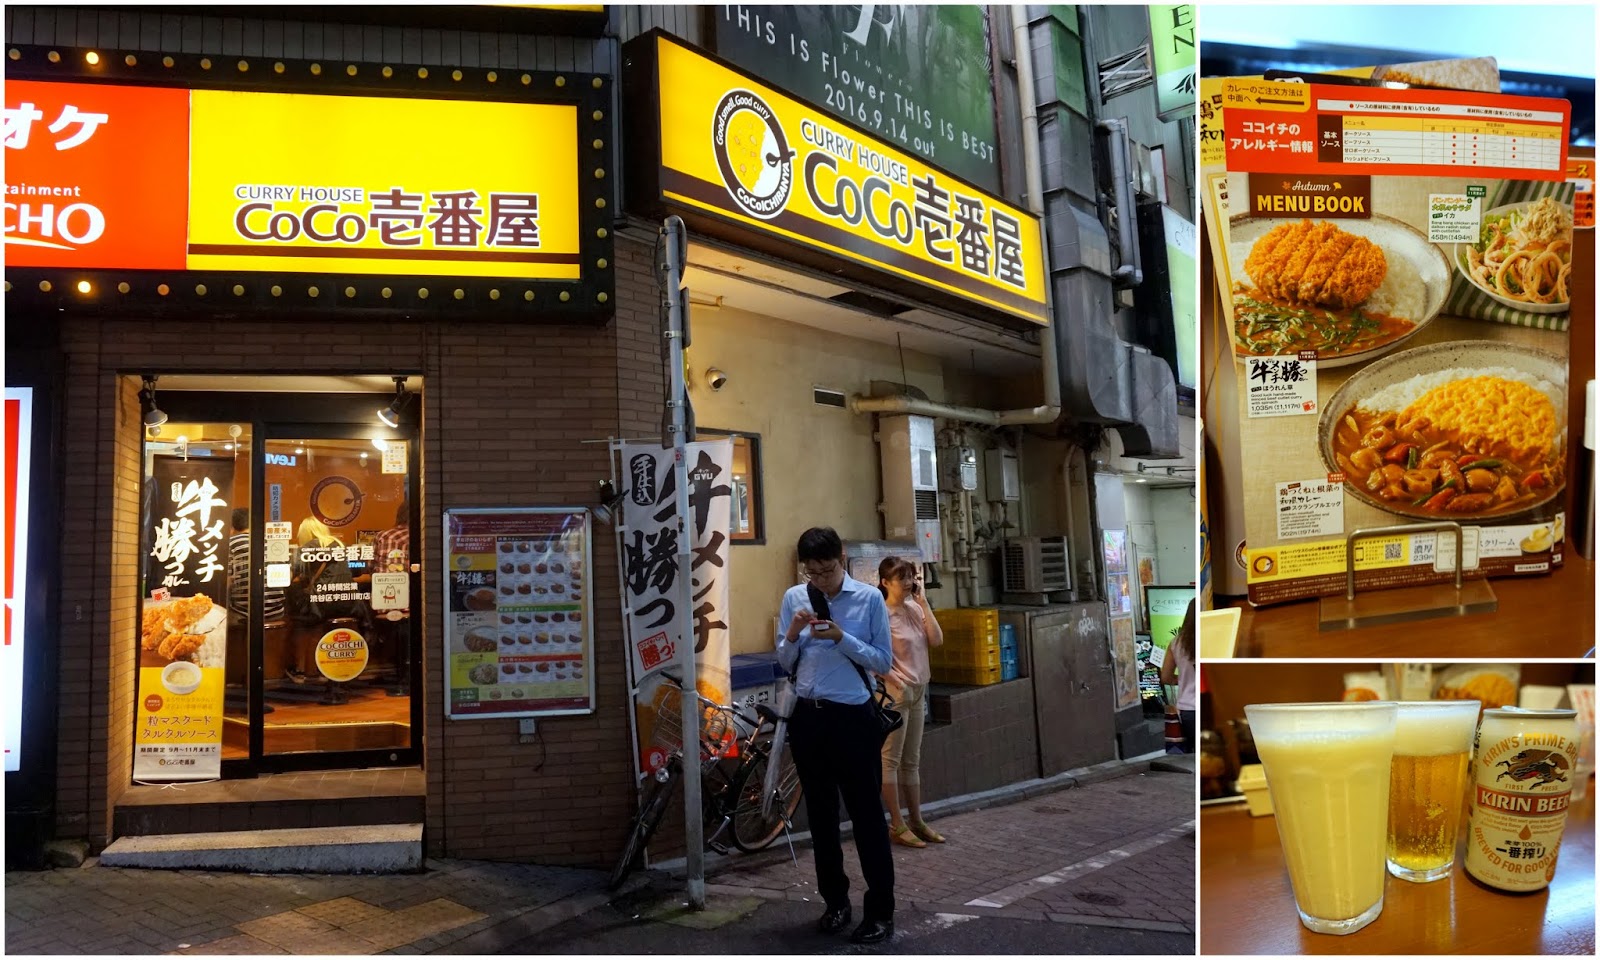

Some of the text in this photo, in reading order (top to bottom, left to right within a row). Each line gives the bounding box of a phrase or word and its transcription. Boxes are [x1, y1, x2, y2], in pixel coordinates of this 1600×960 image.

[1227, 84, 1304, 97] カレーのご注文方法は
[791, 34, 810, 62] IS
[822, 52, 885, 103] Flower
[894, 92, 932, 130] THIS
[941, 118, 955, 142] IS
[962, 131, 994, 163] BEST
[1228, 94, 1252, 103] 中面へ
[716, 116, 726, 145] Good
[735, 95, 752, 106] Good
[753, 101, 770, 120] curry
[824, 83, 935, 157] 2016.9.14 out
[1243, 121, 1300, 135] ココイチの
[1323, 131, 1337, 139] 基本
[1230, 138, 1313, 153] アレルギー情報
[1321, 140, 1340, 148] ソース
[801, 121, 908, 184] CURRY HOUSE
[5, 183, 81, 196] tainment
[1292, 181, 1331, 191] Autumn
[236, 186, 362, 202] CURRY HOUSE
[1257, 195, 1364, 213] MENU BOOK
[236, 190, 540, 247] CoCo壱番屋
[804, 151, 1026, 289] CoCo壱番屋
[1292, 501, 1341, 511] スクランブルエッグ
[301, 545, 375, 562] CoCo壱番屋
[316, 583, 358, 592] 24時間営業
[148, 715, 212, 727] 粒マスタード
[143, 728, 217, 739] タルタルソース
[1483, 736, 1520, 767] KIRIN'S
[1524, 733, 1566, 749] PRIME
[1481, 791, 1532, 812] KIRIN
[1475, 827, 1550, 874] BREWED FOR GOOD
[1496, 847, 1546, 859] 一番搾り
